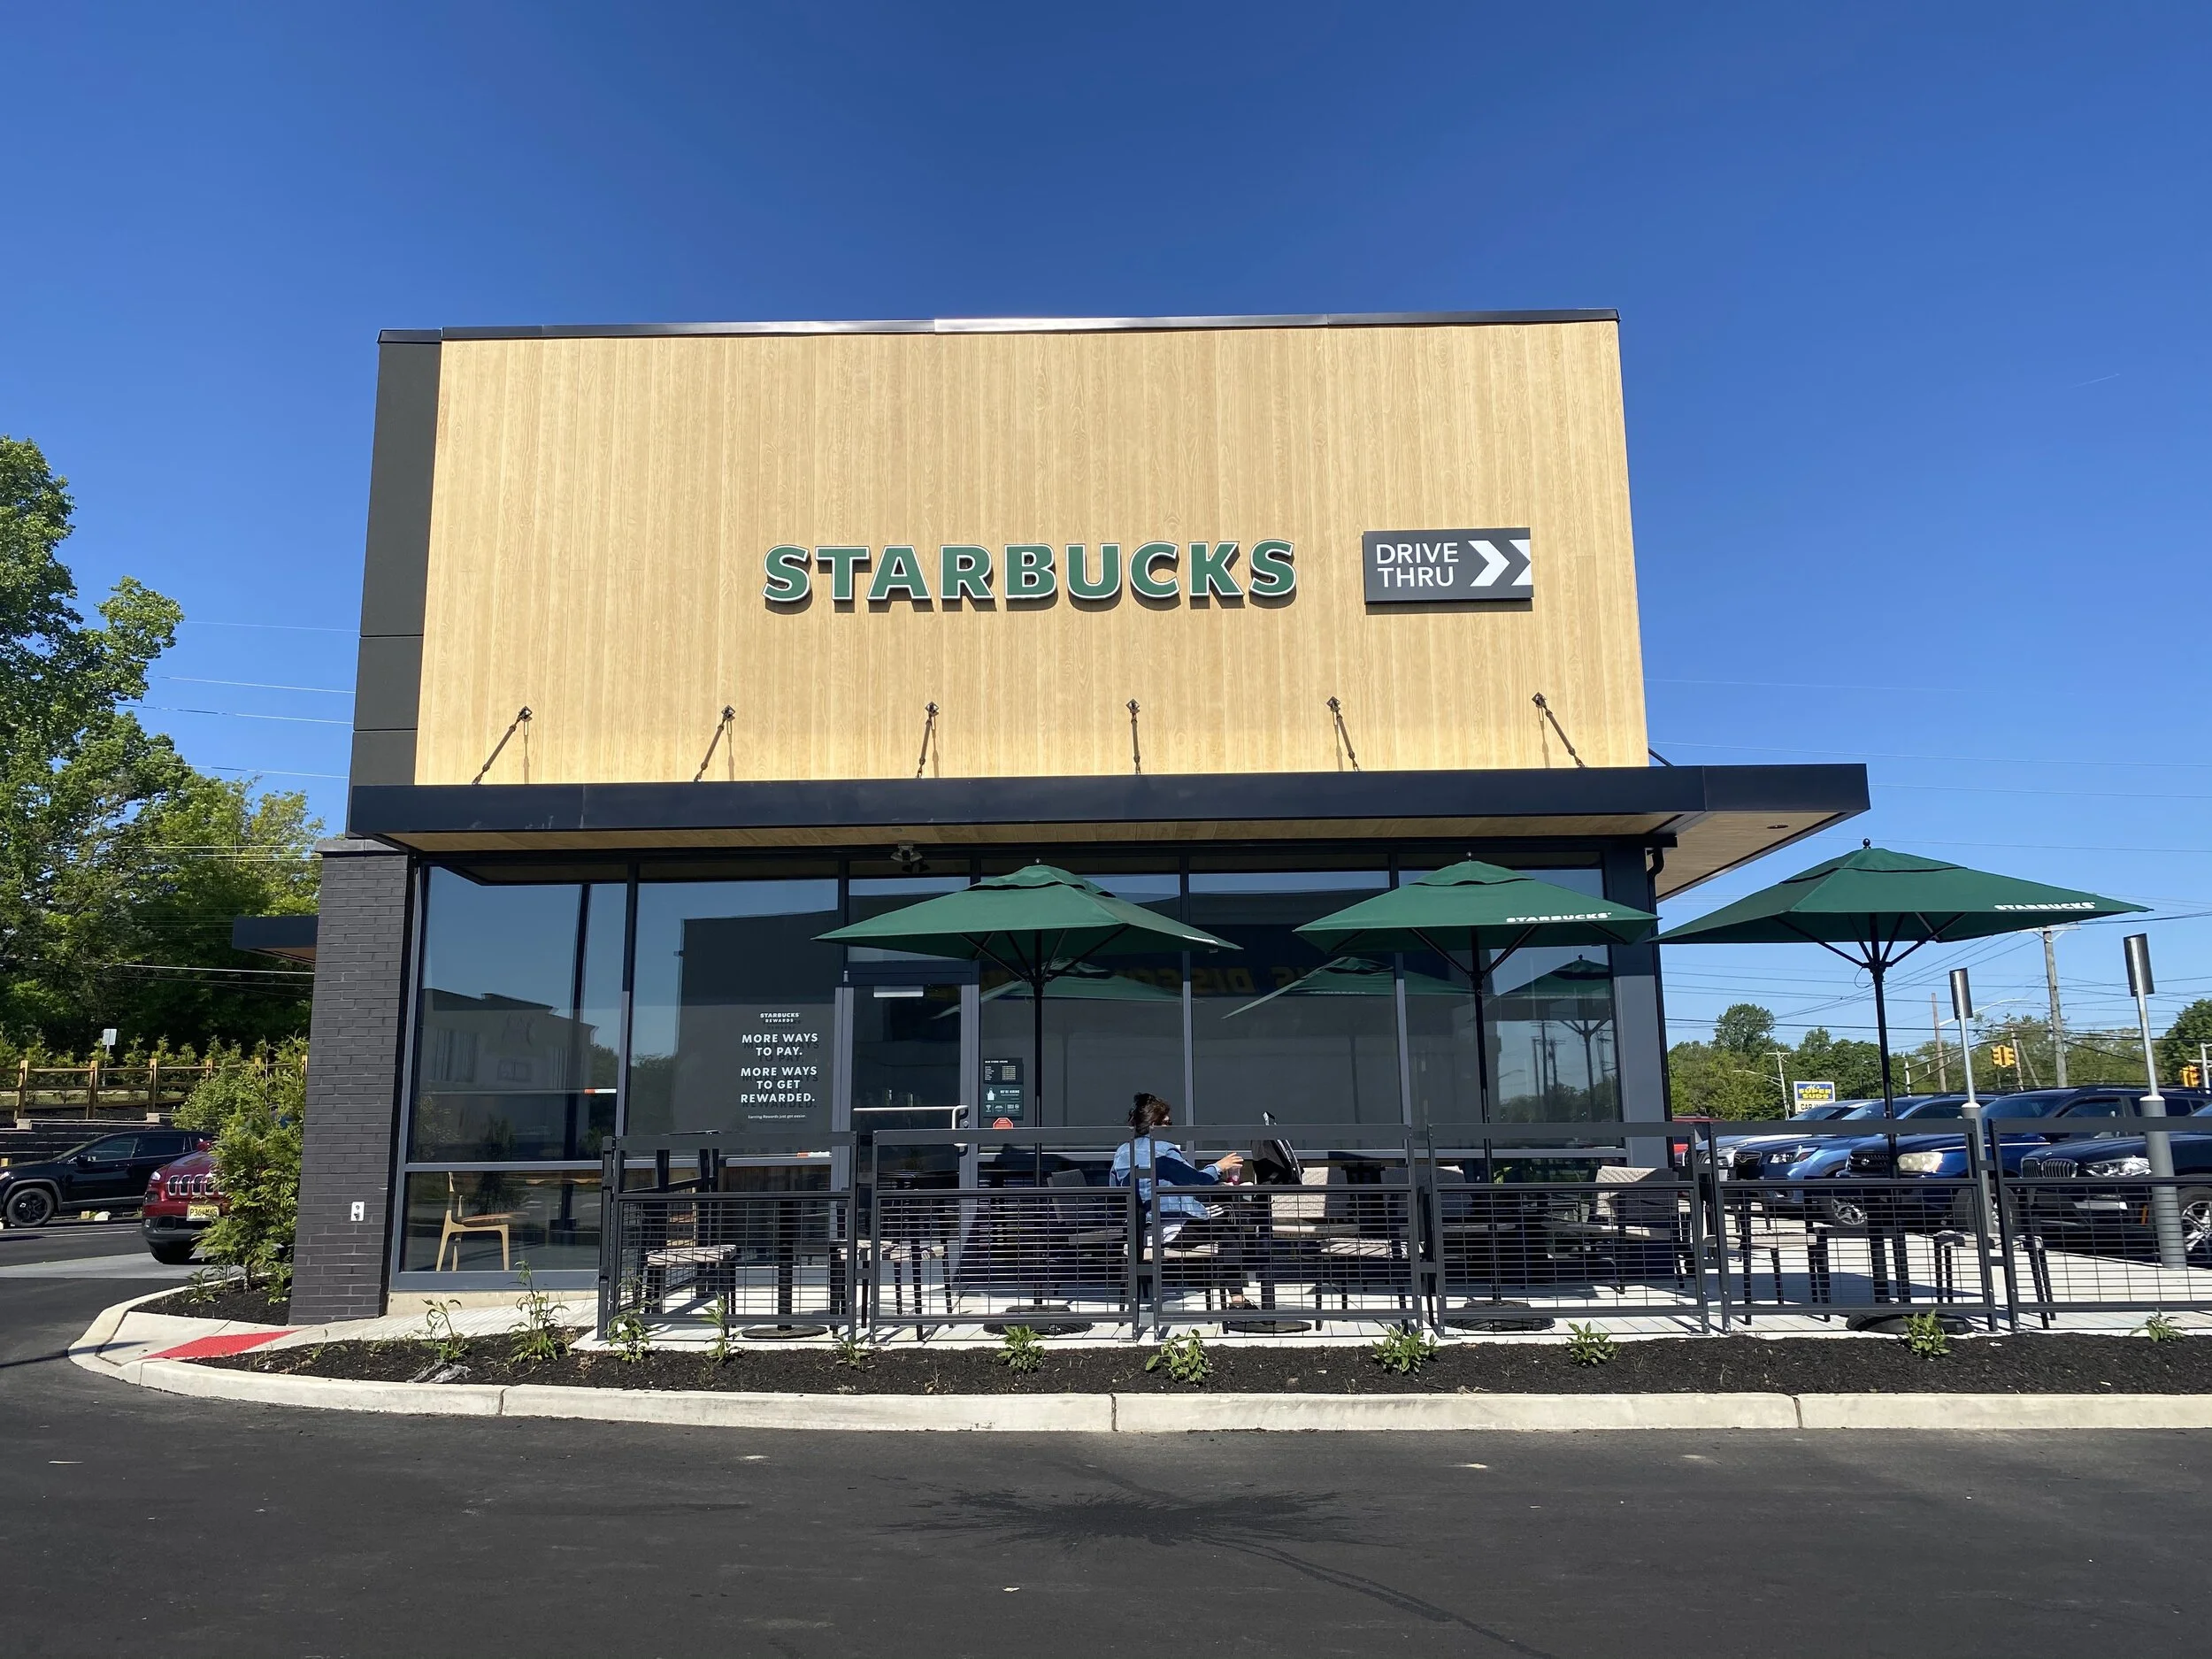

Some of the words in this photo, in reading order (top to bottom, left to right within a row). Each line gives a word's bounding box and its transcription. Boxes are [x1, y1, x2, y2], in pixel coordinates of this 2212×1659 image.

[1376, 542, 1459, 565] DRIVE
[762, 539, 1299, 603] STARBUCKS
[1377, 566, 1454, 588] THRU
[1993, 902, 2096, 910] STARBUCKS
[1506, 912, 1610, 923] STARBUCKS
[741, 1034, 779, 1043] MORE
[782, 1033, 818, 1042] WAYS
[756, 1047, 772, 1056] TO
[776, 1047, 803, 1056] PAY.
[740, 1067, 777, 1077] MORE
[781, 1066, 818, 1076] WAYS
[757, 1080, 772, 1089] TO
[777, 1079, 801, 1089] GET
[741, 1093, 816, 1103] REWARDED.
